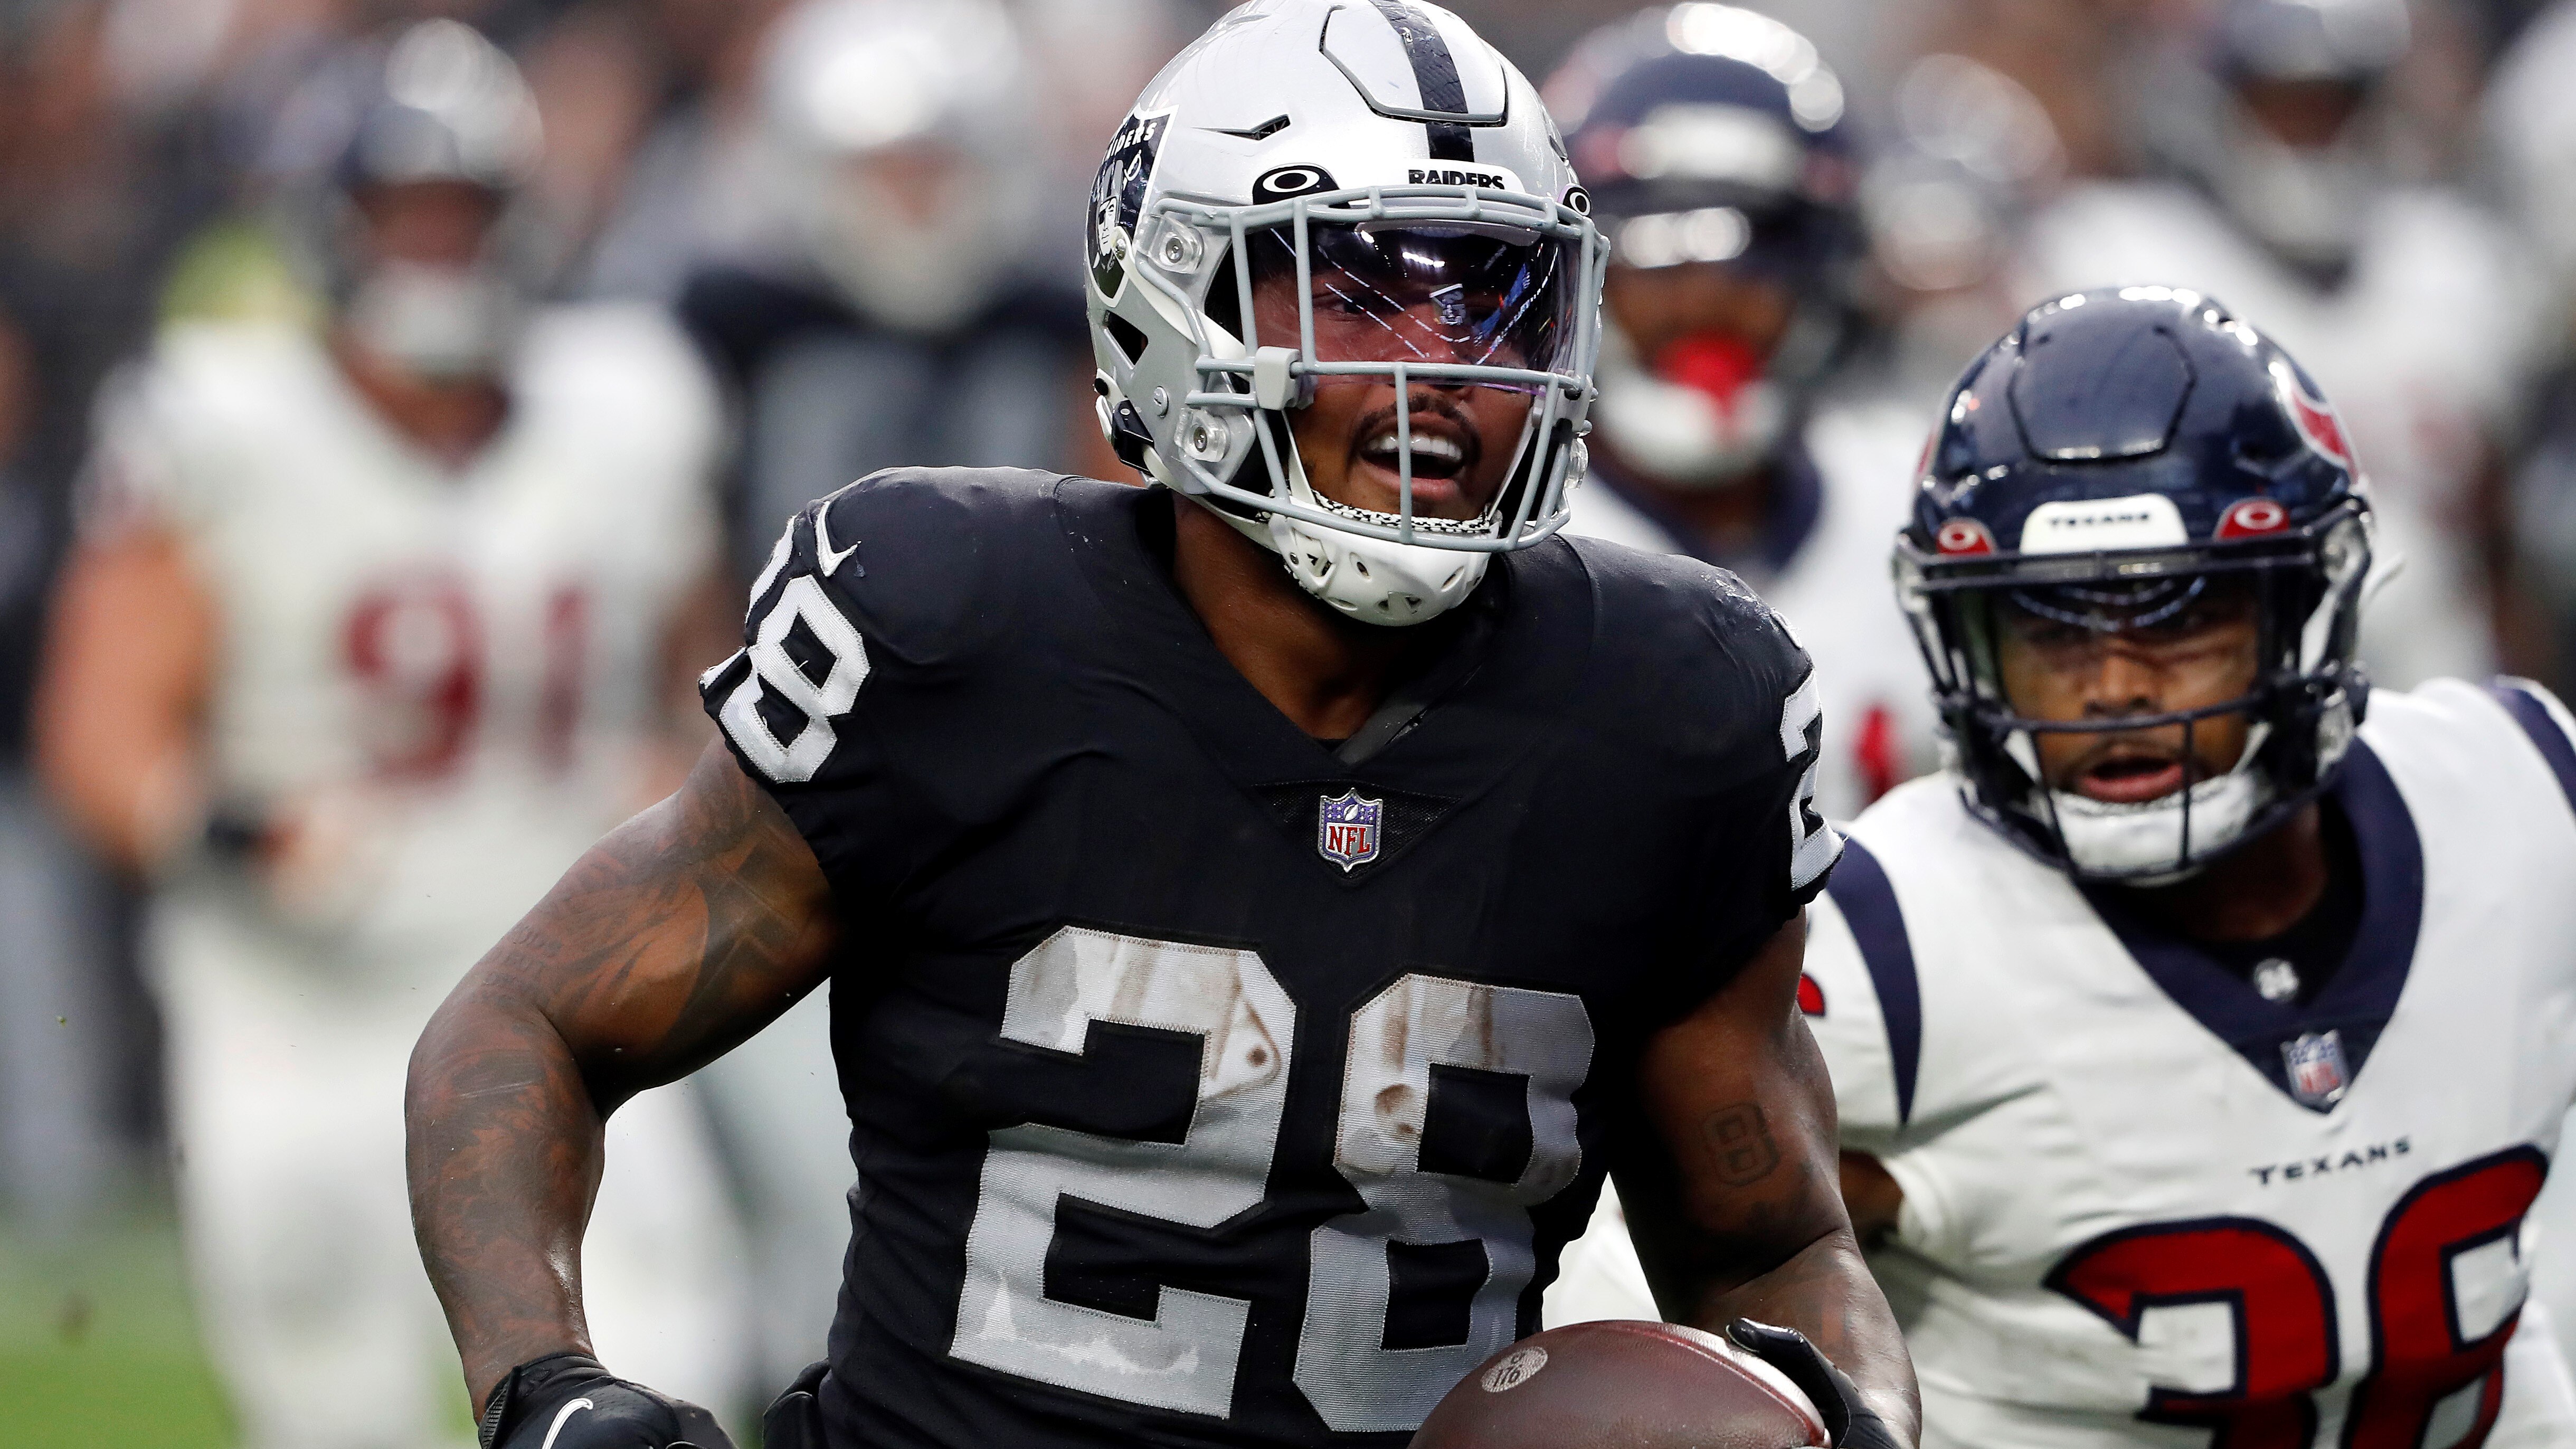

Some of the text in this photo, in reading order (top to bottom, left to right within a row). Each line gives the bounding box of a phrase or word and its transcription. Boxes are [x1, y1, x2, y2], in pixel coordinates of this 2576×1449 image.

[1408, 169, 1505, 190] RAIDERS
[1328, 826, 1370, 857] NFL
[949, 925, 1595, 1433] 28
[2247, 1136, 2411, 1186] TEXANS
